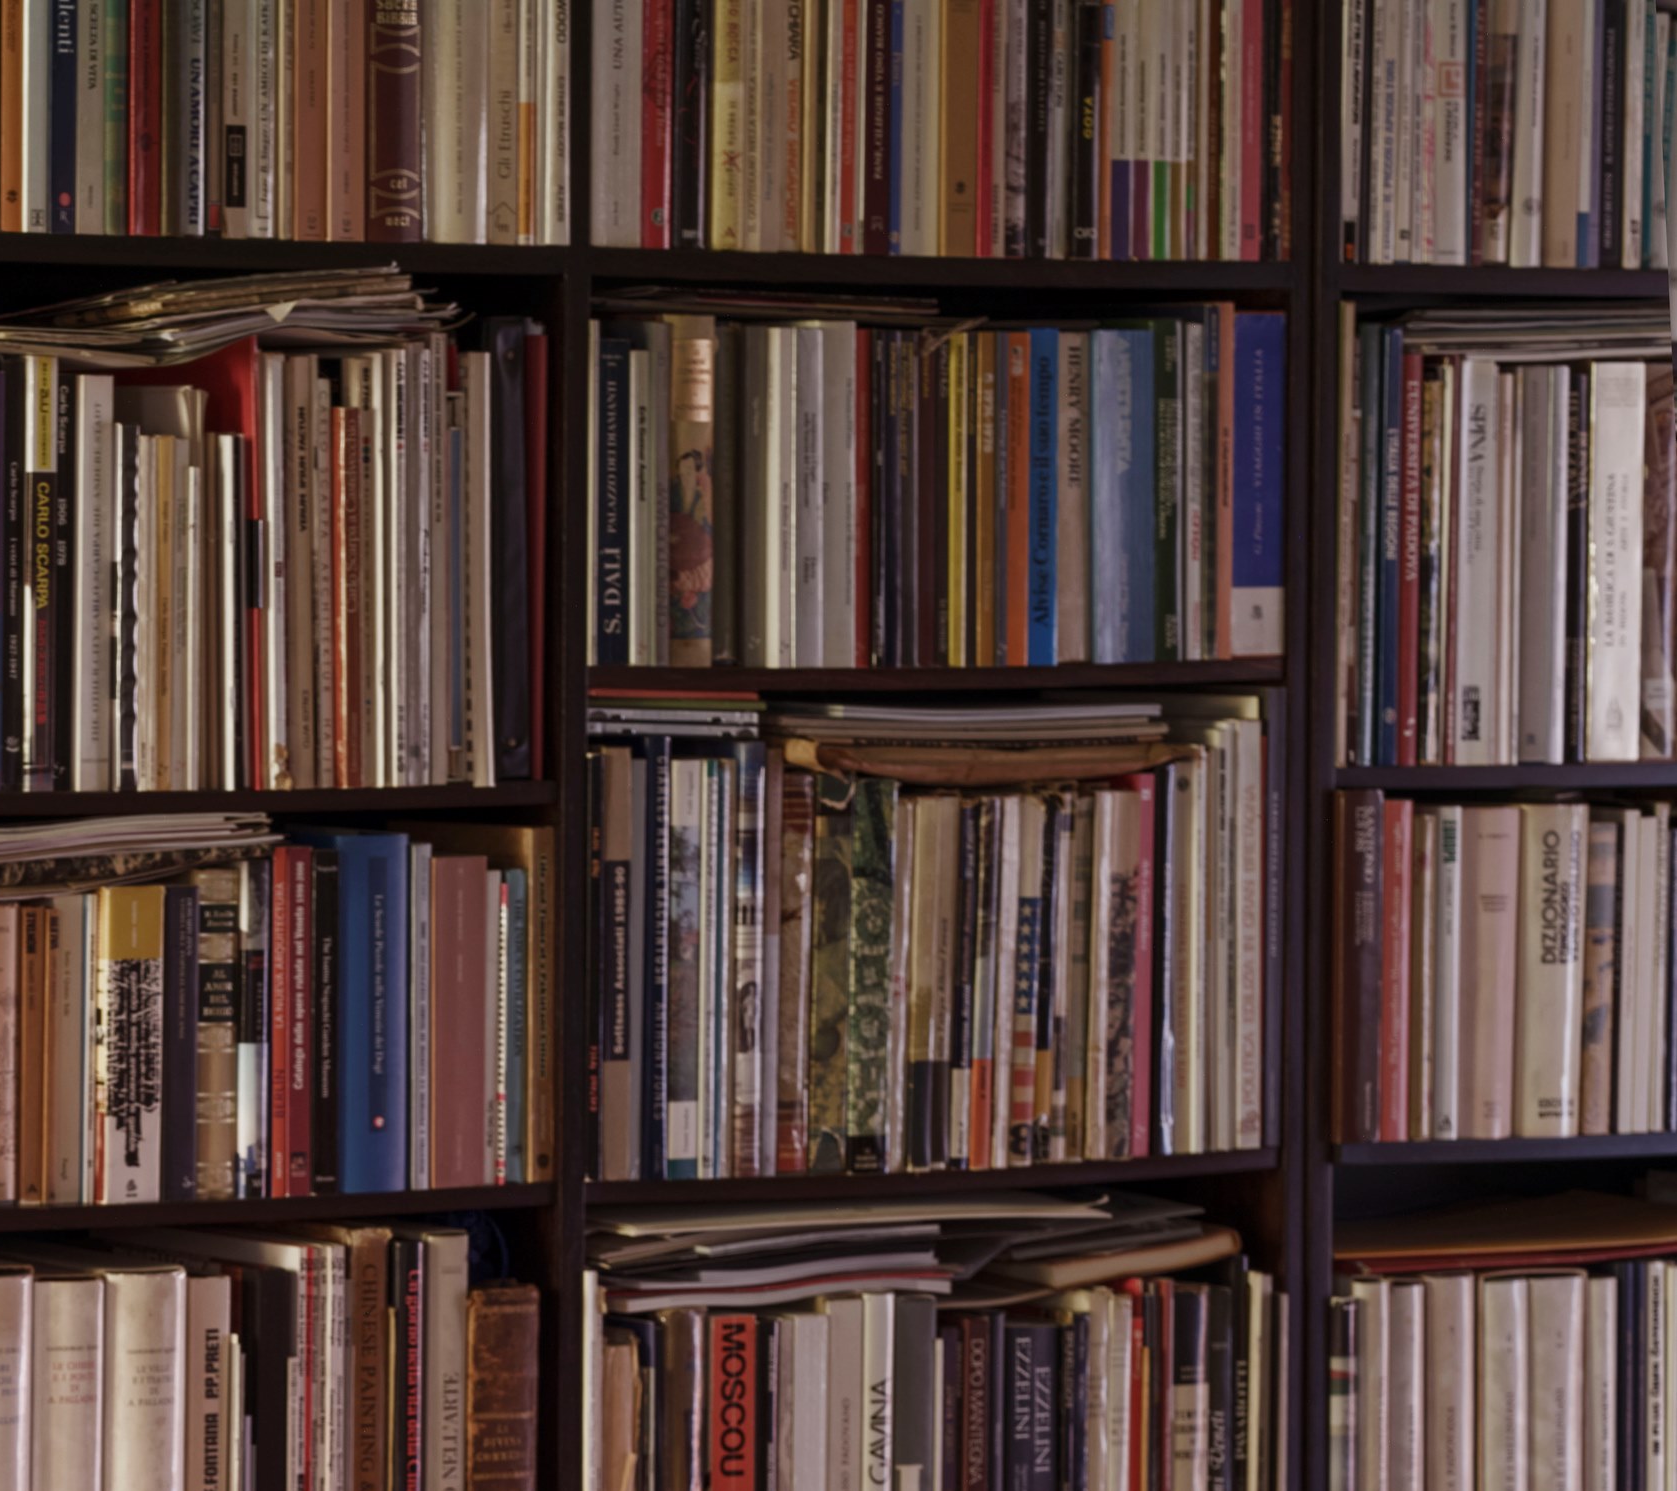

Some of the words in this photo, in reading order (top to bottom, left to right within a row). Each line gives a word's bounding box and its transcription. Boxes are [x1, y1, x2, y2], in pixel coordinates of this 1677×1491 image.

[499, 89, 511, 150] Etruschi
[497, 156, 511, 178] Gli
[1067, 346, 1080, 408] HENRY
[1067, 418, 1080, 488] MOORE
[36, 482, 49, 538] CARLO
[35, 544, 48, 609] SCARPA
[1540, 830, 1561, 964] DIZIONARIO
[361, 1262, 377, 1354] CHINESE
[360, 1366, 376, 1471] PAINTING
[720, 1322, 745, 1476] MOSCOU
